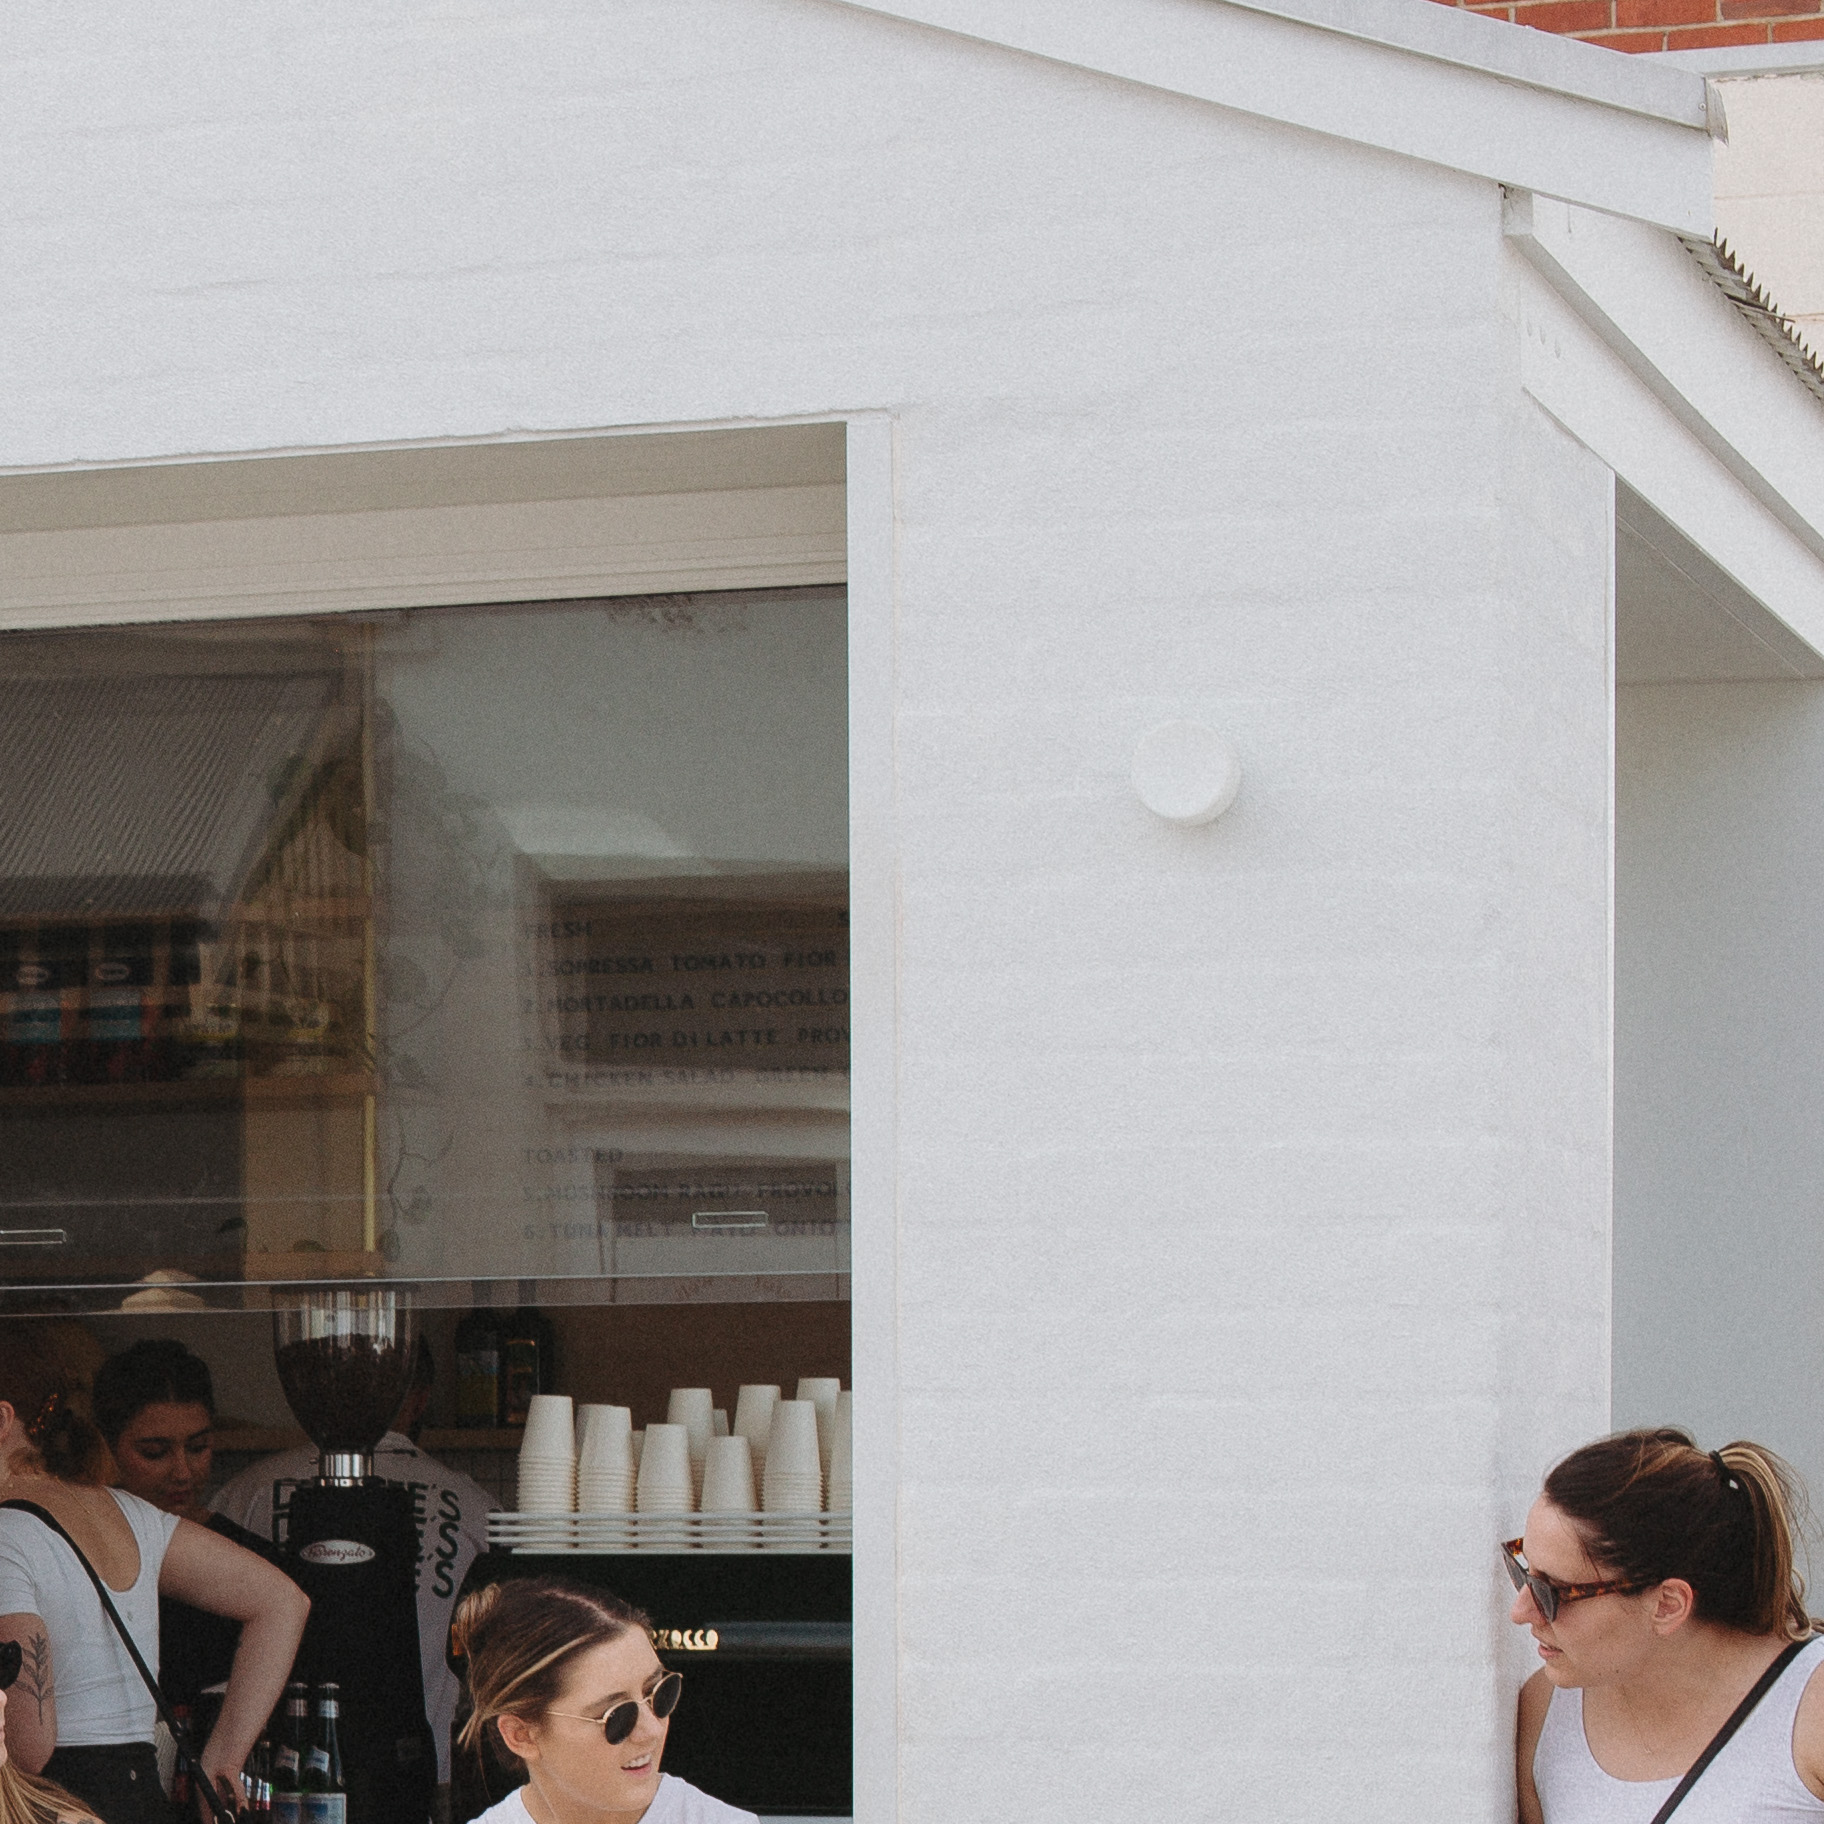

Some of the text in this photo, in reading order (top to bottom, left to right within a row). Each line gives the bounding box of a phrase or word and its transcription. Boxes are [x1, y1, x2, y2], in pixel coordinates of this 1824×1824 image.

[523, 919, 593, 940] FRESH
[671, 950, 767, 973] TOMATO
[783, 949, 838, 969] FIOR
[710, 987, 849, 1010] CAPOCOLLO
[609, 1030, 663, 1051] FIOR
[672, 1029, 699, 1048] DI
[706, 1027, 779, 1048] LATTE
[522, 1147, 624, 1165] TOASTED
